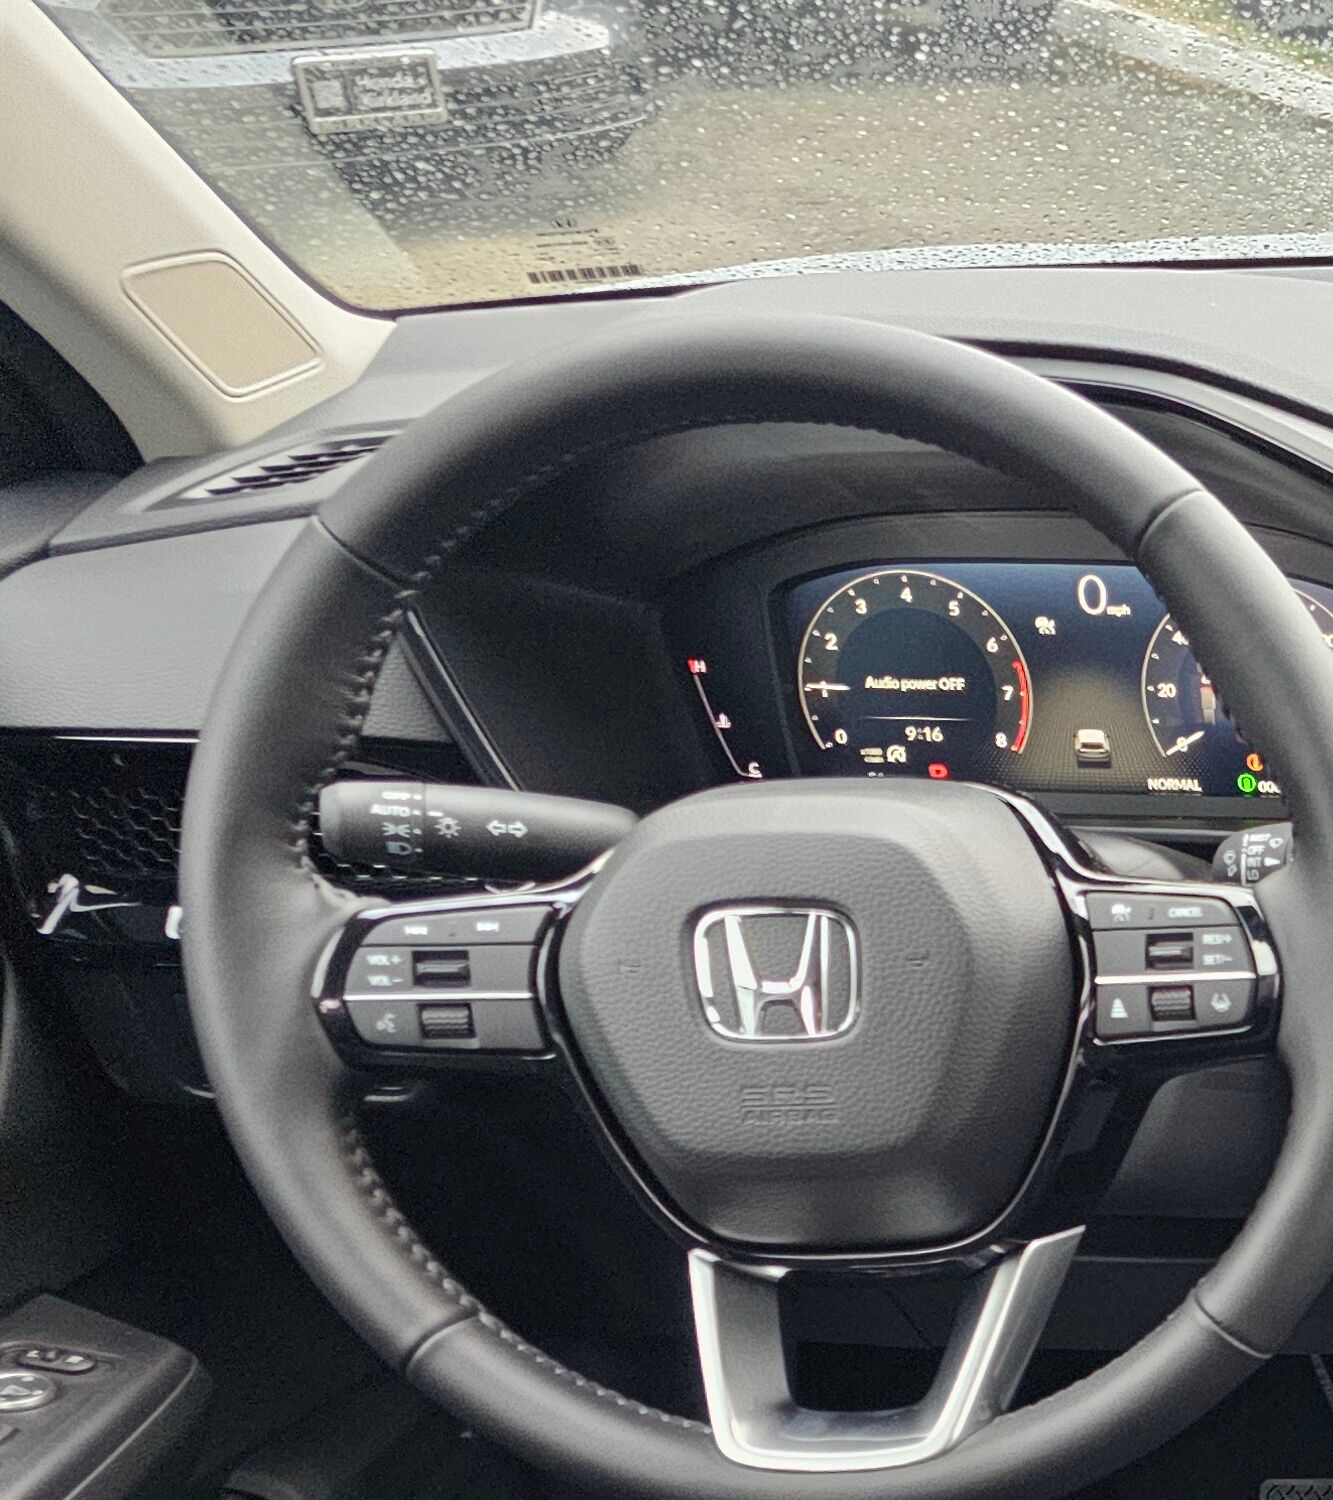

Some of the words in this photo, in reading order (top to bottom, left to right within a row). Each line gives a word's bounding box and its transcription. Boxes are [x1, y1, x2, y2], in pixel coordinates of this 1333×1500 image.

[900, 587, 913, 603] 4
[1077, 574, 1107, 616] 0
[1106, 604, 1131, 617] mph
[855, 599, 867, 615] 3
[949, 600, 960, 617] 5
[825, 632, 838, 651] 2
[986, 636, 999, 653] 6
[865, 675, 900, 689] Audio
[900, 677, 938, 692] power
[938, 676, 967, 691] OFF
[1157, 682, 1177, 698] 20
[1002, 684, 1014, 701] 7
[834, 728, 848, 744] 0
[905, 726, 944, 742] 9:16
[995, 732, 1008, 749] 8
[1147, 778, 1202, 793] NORMAL
[371, 803, 410, 817] AUTO
